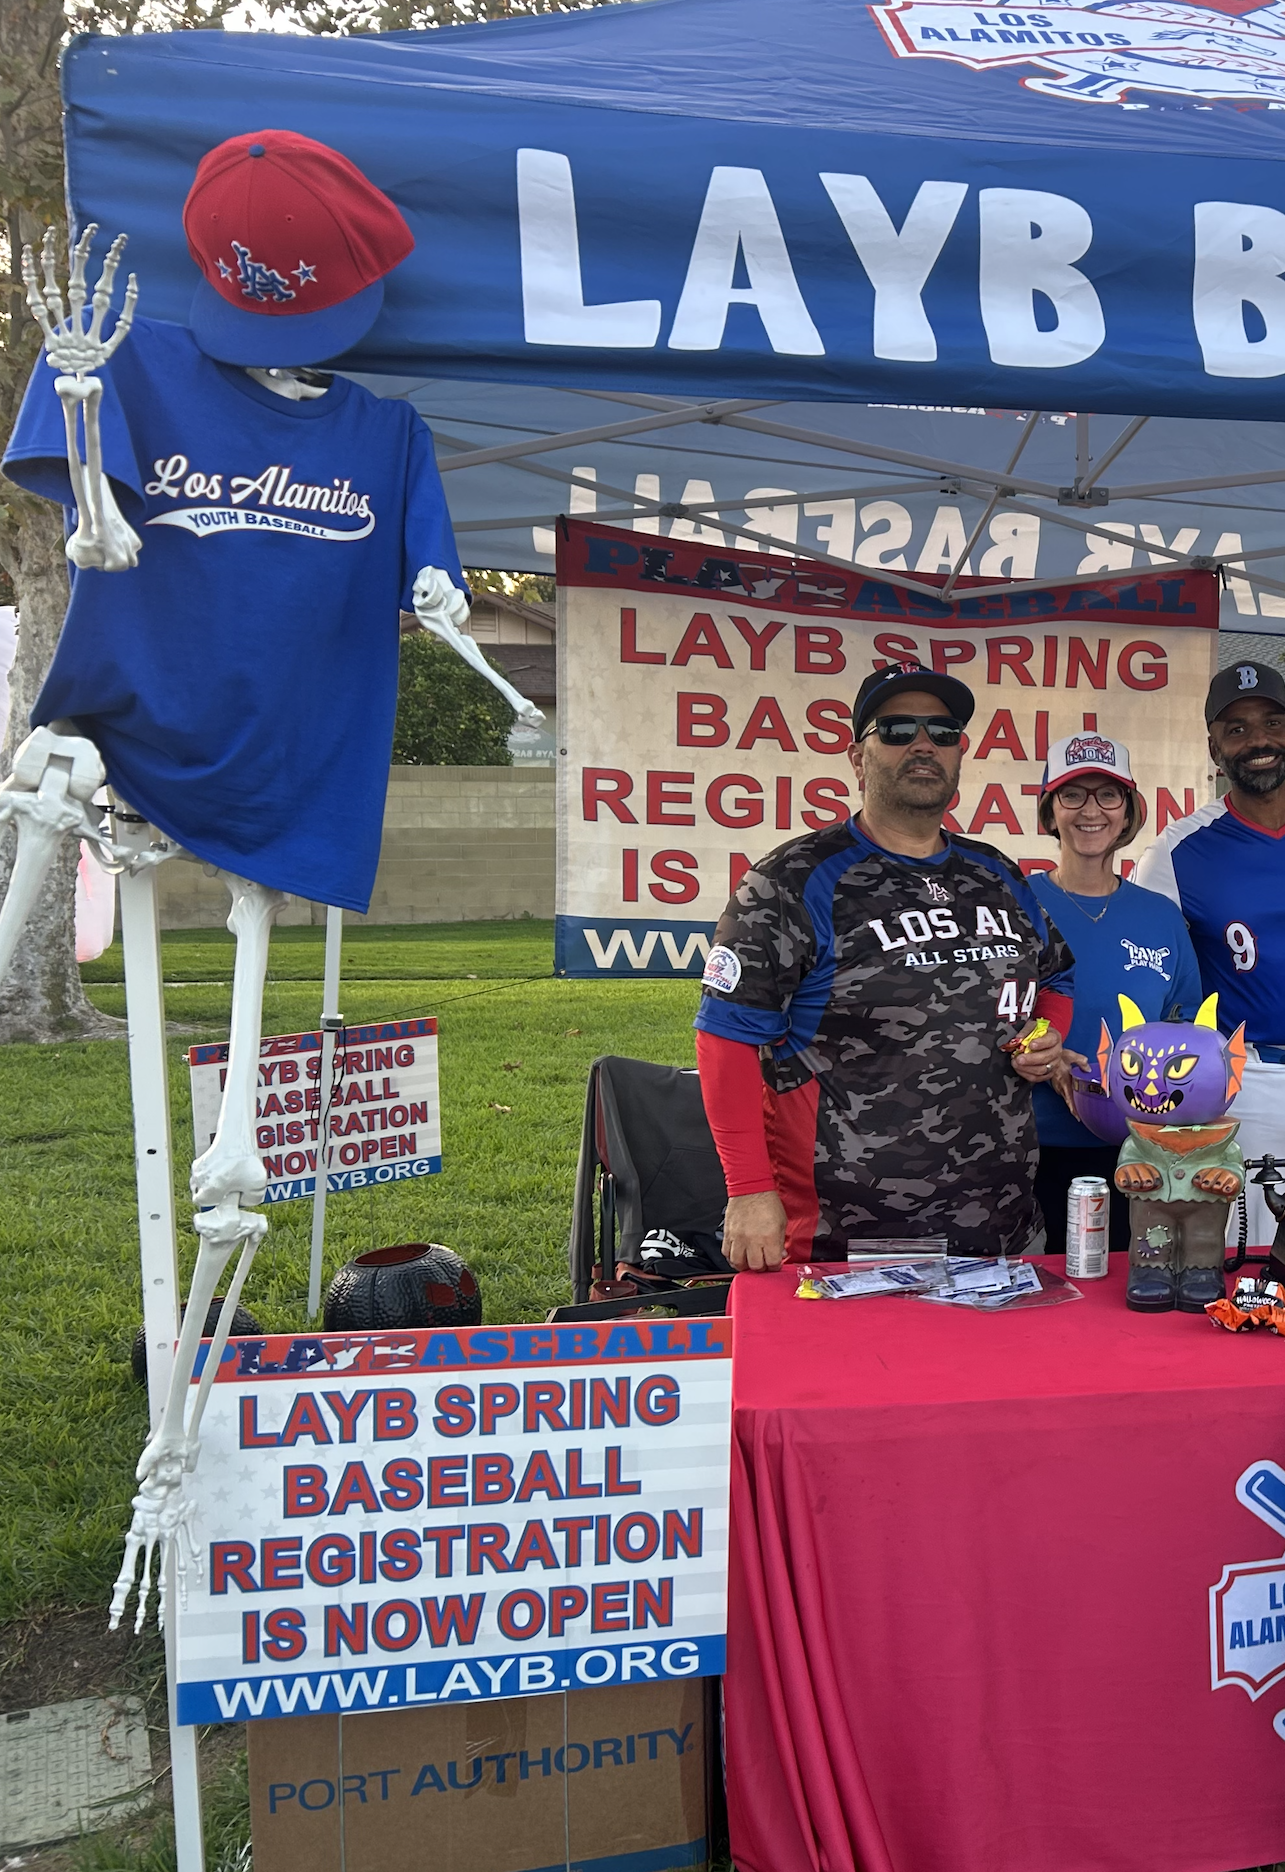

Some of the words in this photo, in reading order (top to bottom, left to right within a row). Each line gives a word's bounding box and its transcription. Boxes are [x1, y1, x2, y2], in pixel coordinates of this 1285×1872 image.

[920, 26, 1132, 47] ALAMITOS
[973, 12, 1053, 28] LOS
[516, 147, 1106, 368] LAYB
[144, 454, 223, 501] Los
[230, 463, 373, 519] Alamitos
[187, 510, 239, 529] YOUTH
[244, 513, 327, 538] BASEBALL
[620, 607, 846, 675] LAYB
[871, 631, 1169, 692] SPRING
[1236, 665, 1258, 691] B
[676, 691, 1098, 761] BASAL
[1067, 747, 1115, 765] MOM
[582, 766, 1193, 836] REGISAN
[622, 847, 700, 906] IS
[868, 908, 960, 952] LOS
[974, 905, 1023, 943] AL
[905, 951, 949, 967] ALL
[953, 945, 1020, 963] STARS
[1129, 945, 1162, 966] LAYB
[1225, 920, 1257, 973] 9
[997, 979, 1038, 1023] 44
[256, 1077, 400, 1119] ASEBALL
[339, 1132, 417, 1166] OPEN
[239, 1388, 417, 1449] LAYB
[432, 1375, 681, 1438] SPRING
[283, 1446, 641, 1518] BASEBALL
[210, 1507, 702, 1595] REGISTRATION
[242, 1608, 307, 1664] IS
[324, 1593, 483, 1658] NOW
[497, 1577, 674, 1641] OPEN
[213, 1641, 701, 1719] WWW.LAYB.ORG
[269, 1768, 400, 1814] PORT
[410, 1722, 694, 1793] AUTHORITY
